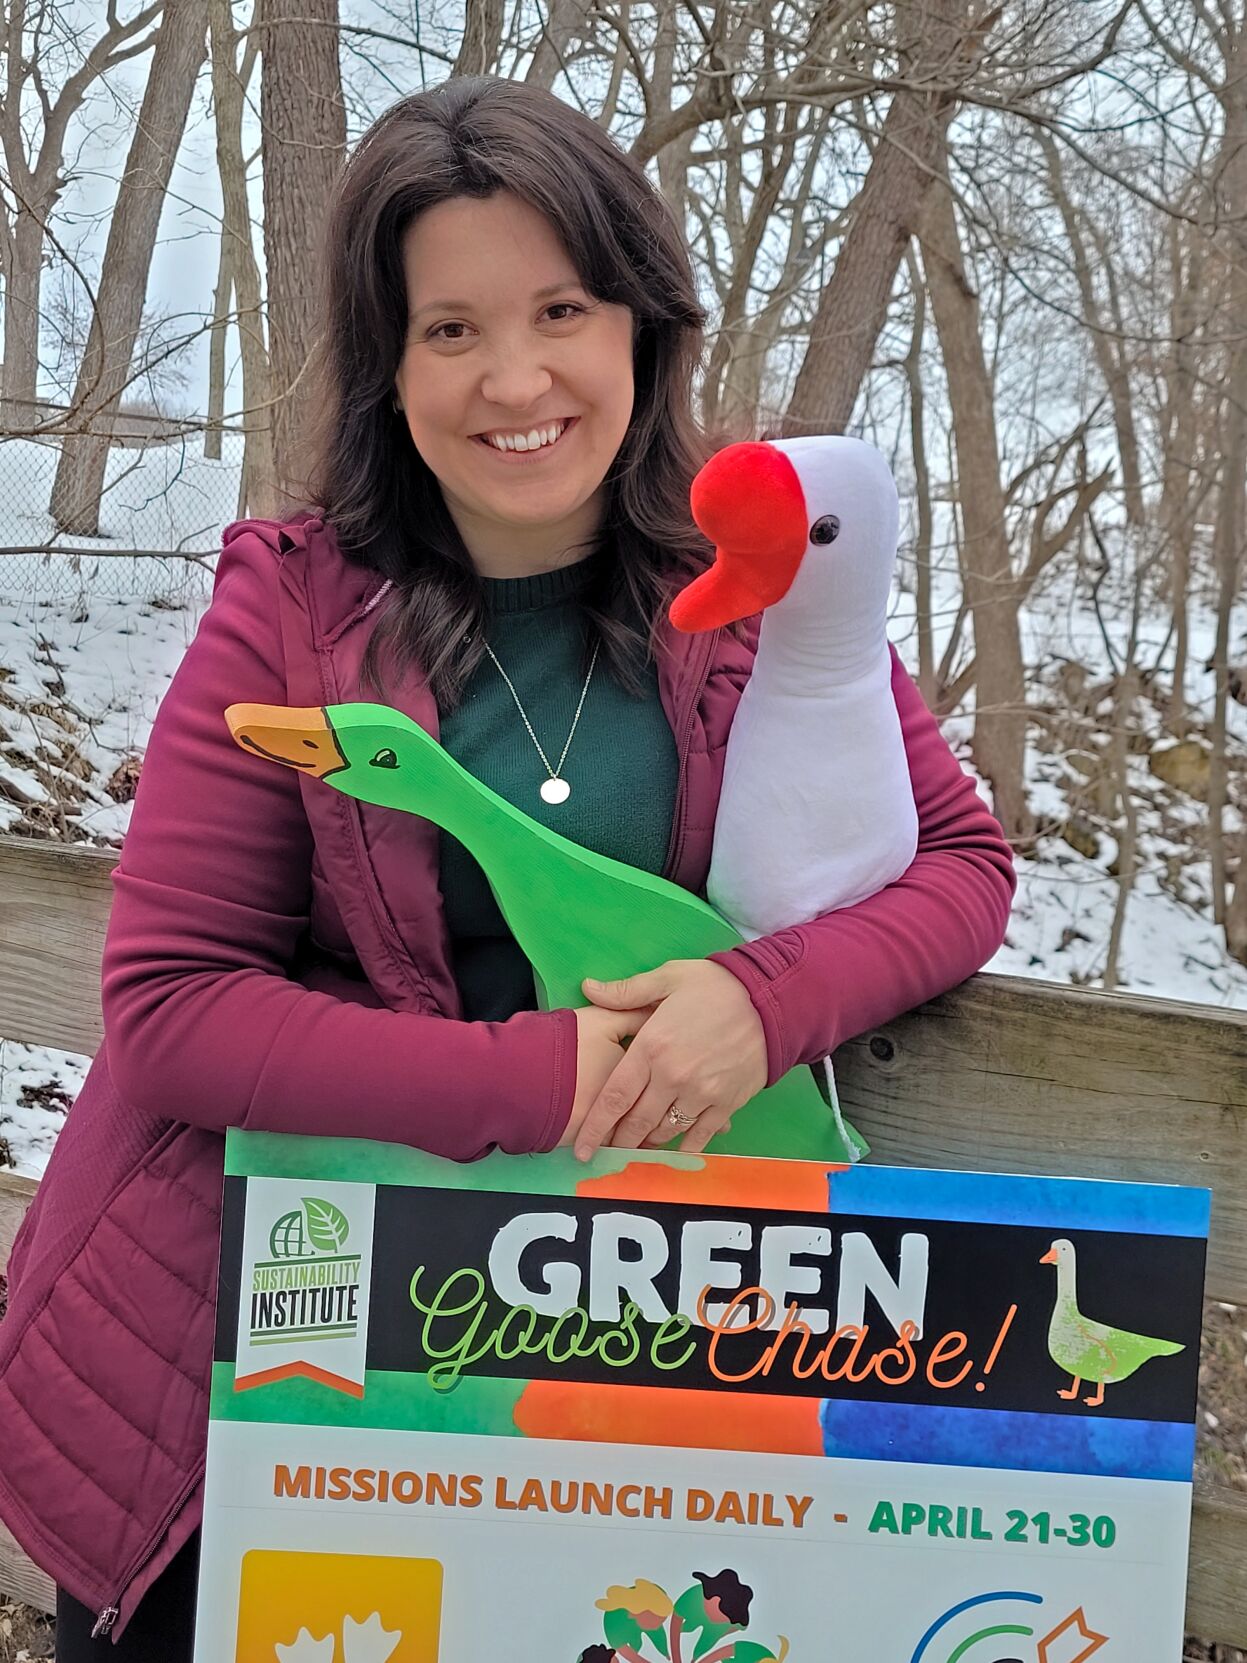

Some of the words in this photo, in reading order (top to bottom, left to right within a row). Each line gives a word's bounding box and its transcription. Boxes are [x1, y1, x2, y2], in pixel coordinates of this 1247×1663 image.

[249, 1284, 359, 1330] INSTITUTE
[252, 1260, 360, 1292] SUSTAINABILITY
[488, 1212, 930, 1340] GREEN
[410, 1265, 697, 1391] Goose
[697, 1284, 1018, 1392] Chase!
[273, 1464, 484, 1508] MISSIONS
[495, 1477, 673, 1520] LAUNCH
[686, 1488, 814, 1529] DAILY
[867, 1500, 993, 1542] APRIL
[1004, 1509, 1118, 1549] 21-30
